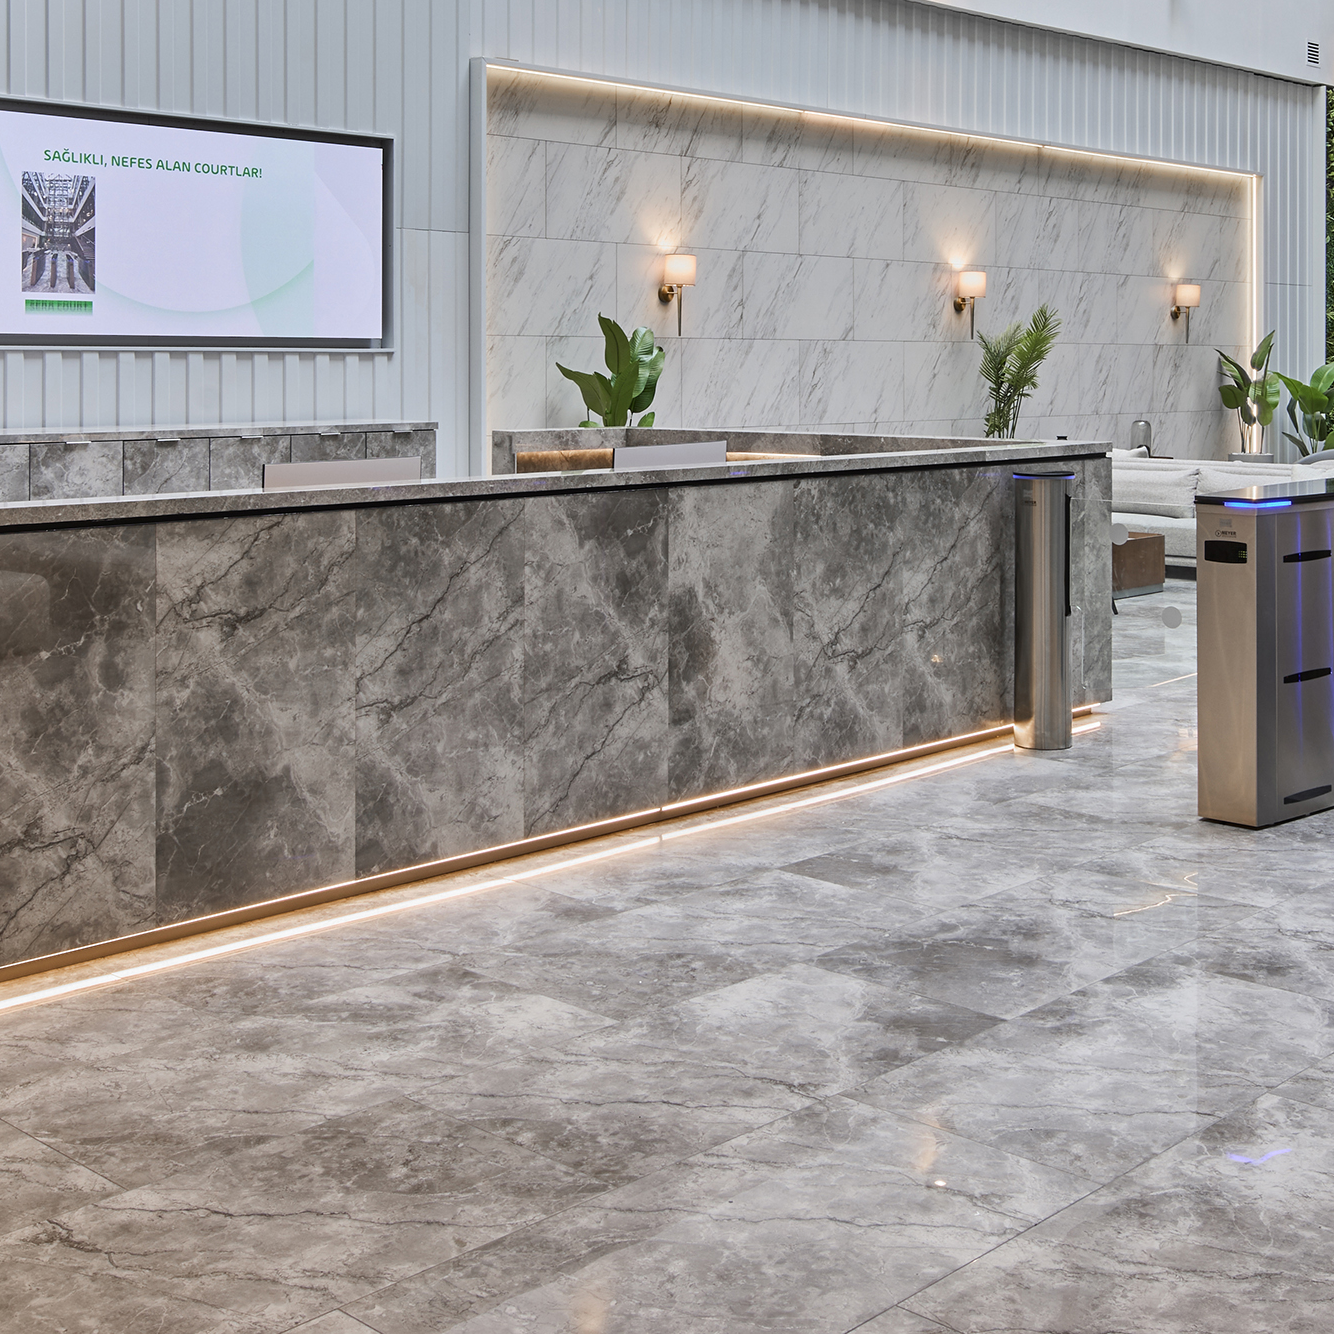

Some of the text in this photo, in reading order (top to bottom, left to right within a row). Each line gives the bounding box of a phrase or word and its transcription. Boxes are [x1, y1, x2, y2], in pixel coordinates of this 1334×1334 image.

[43, 148, 263, 178] SAĞLIKLI, NEFES ALAN COURTLAR!
